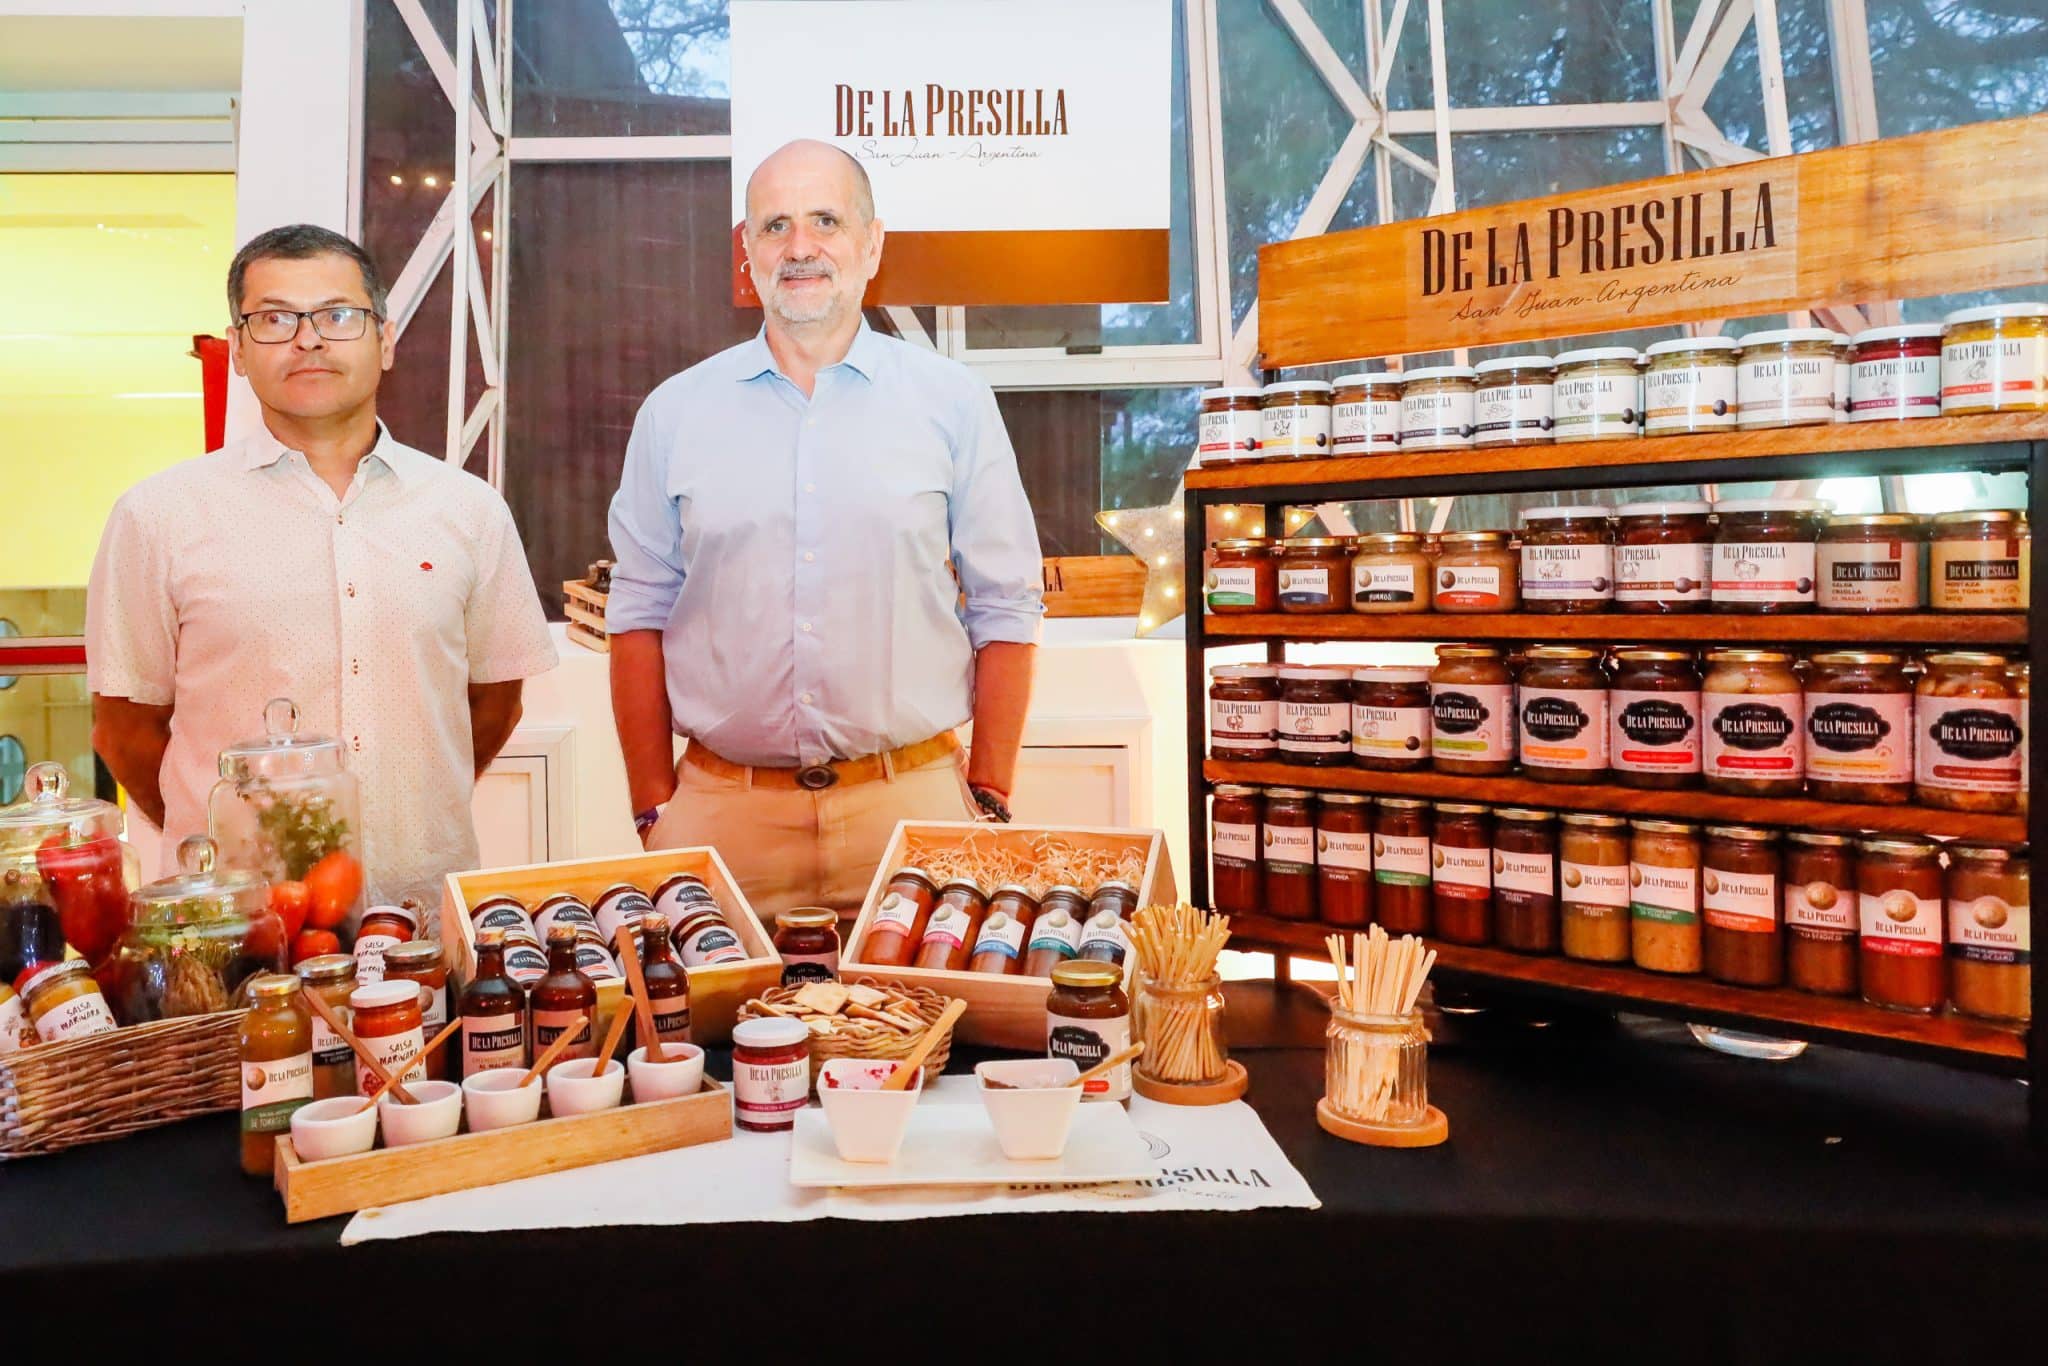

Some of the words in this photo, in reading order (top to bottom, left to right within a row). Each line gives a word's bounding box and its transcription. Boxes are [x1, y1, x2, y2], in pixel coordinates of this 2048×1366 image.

[835, 83, 873, 136] DE
[883, 90, 916, 136] LA
[925, 83, 1068, 136] PRESILLA
[855, 139, 890, 160] San
[887, 138, 942, 167] Juan
[957, 142, 1041, 167] Argentina
[1421, 228, 1473, 297] DE
[1487, 221, 1533, 289] LA
[1547, 182, 1777, 280] PRESILLA
[1450, 297, 1507, 323] San
[1959, 347, 1969, 361] LA
[1754, 364, 1764, 378] DE
[1766, 364, 1776, 377] LA
[1868, 365, 1877, 377] LA
[1836, 566, 1847, 578] DE
[1847, 567, 1857, 578] LA
[1859, 566, 1898, 578] PRESILLA
[1950, 565, 1960, 578] DE
[1962, 566, 1972, 577] LA
[1974, 564, 2016, 578] PRESILLA
[1441, 706, 1448, 718] LA
[1448, 706, 1480, 720] PRESILLA
[1527, 712, 1534, 723] DE
[1535, 713, 1543, 724] LA
[1543, 712, 1579, 727] PRESILLA
[1627, 715, 1636, 728] DE
[1637, 716, 1647, 728] LA
[1648, 715, 1685, 729] PRESILLA
[1722, 719, 1733, 733] DE
[1734, 720, 1744, 733] LA
[1746, 719, 1784, 733] PRESILLA
[1814, 719, 1823, 733] DE
[1824, 720, 1834, 733] LA
[1835, 720, 1879, 735] PRESILLA
[1941, 725, 1953, 740] DE
[1956, 727, 1967, 741] LA
[1969, 726, 2014, 743] PRESILLA
[66, 1001, 92, 1017] SALSA
[60, 1008, 101, 1031] MARINARA
[389, 1039, 413, 1053] SALSA
[472, 1036, 481, 1050] DE
[482, 1035, 491, 1049] LA
[492, 1030, 521, 1048] PRESILLA
[1052, 1037, 1060, 1053] DE
[1060, 1041, 1067, 1054] LA
[1068, 1040, 1102, 1057] PRESILLA
[750, 1067, 759, 1081] DE
[760, 1068, 769, 1081] LA
[771, 1064, 802, 1081] PRESILLA
